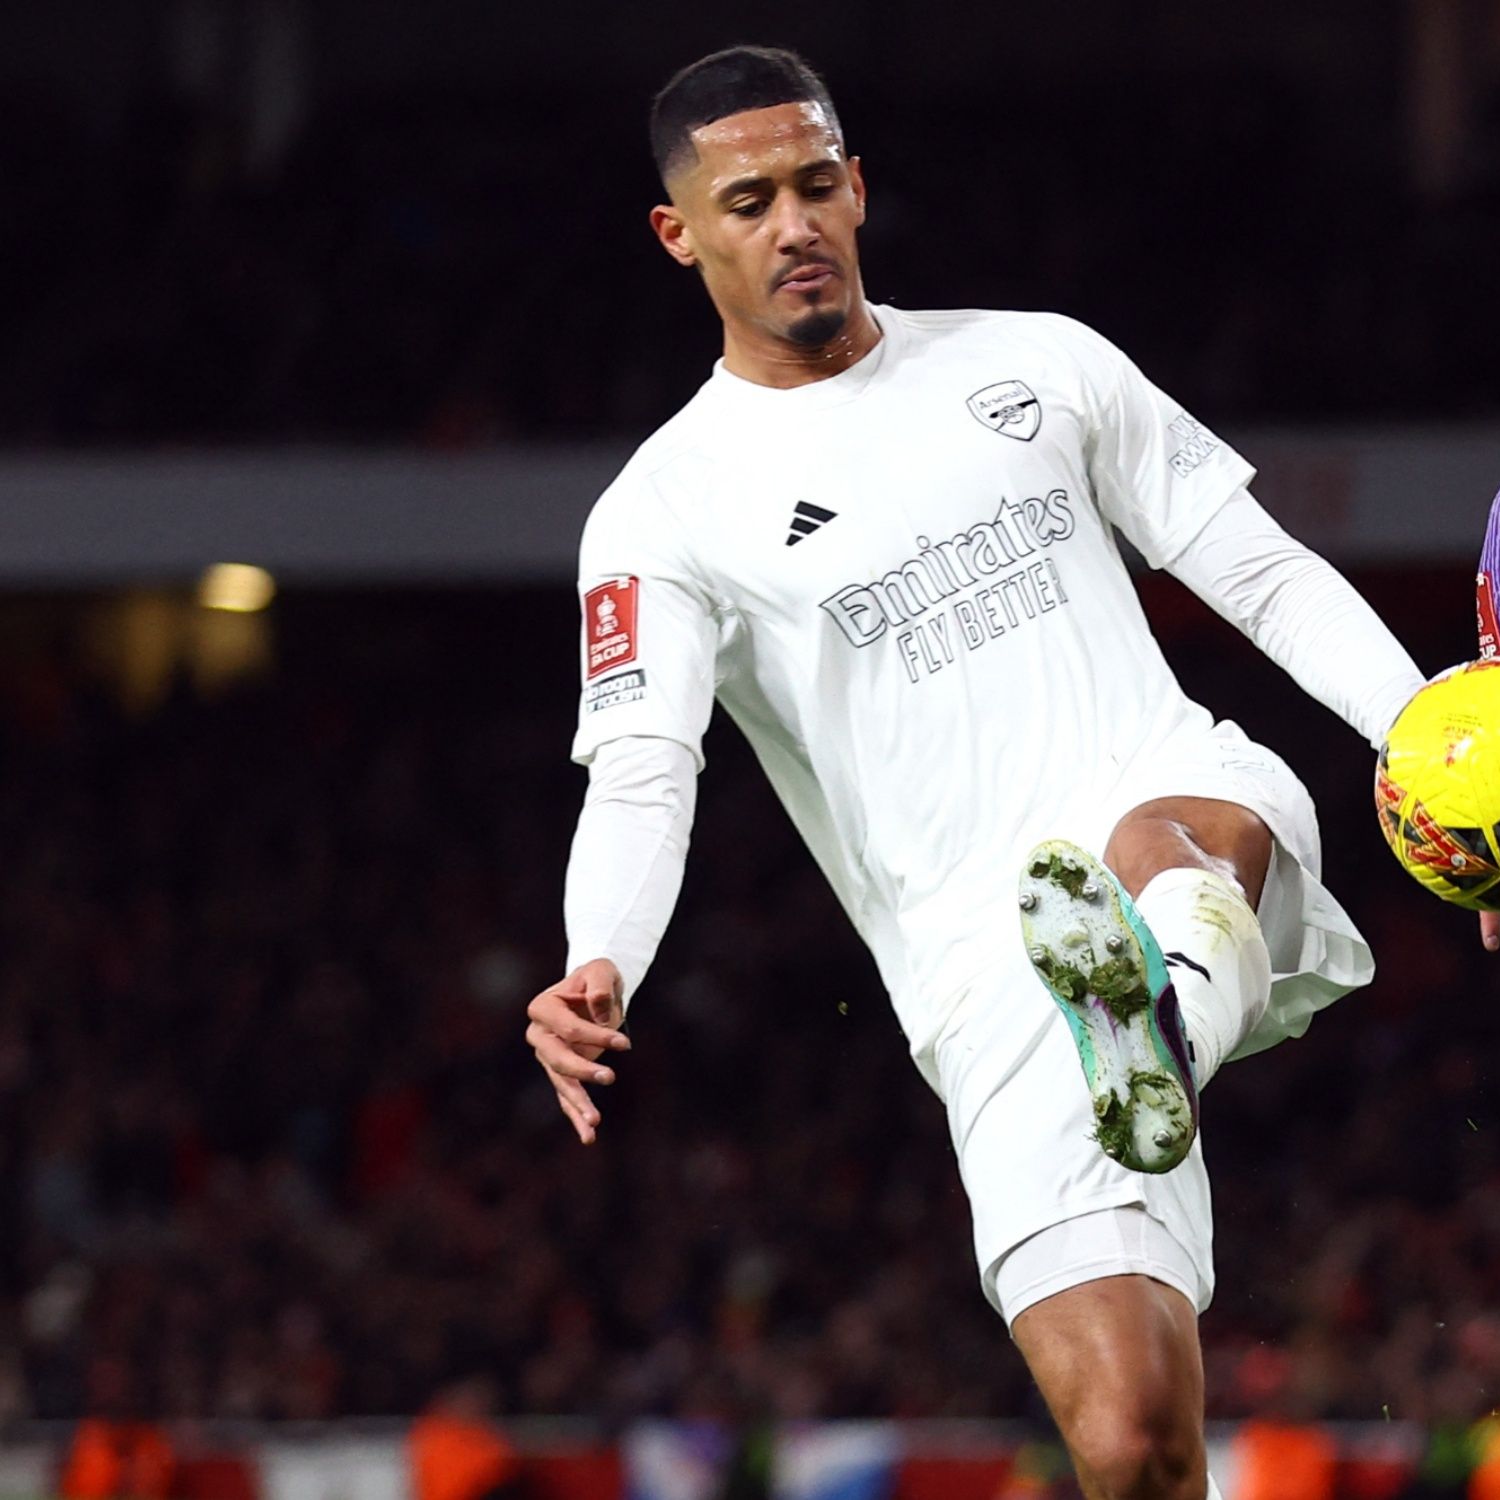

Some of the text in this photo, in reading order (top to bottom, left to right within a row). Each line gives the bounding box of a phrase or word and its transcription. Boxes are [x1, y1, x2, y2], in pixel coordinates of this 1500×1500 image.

[978, 386, 1025, 410] Arsenal
[818, 489, 1075, 649] Emirates
[602, 641, 630, 661] CUP
[896, 556, 1069, 684] FLY BETTER
